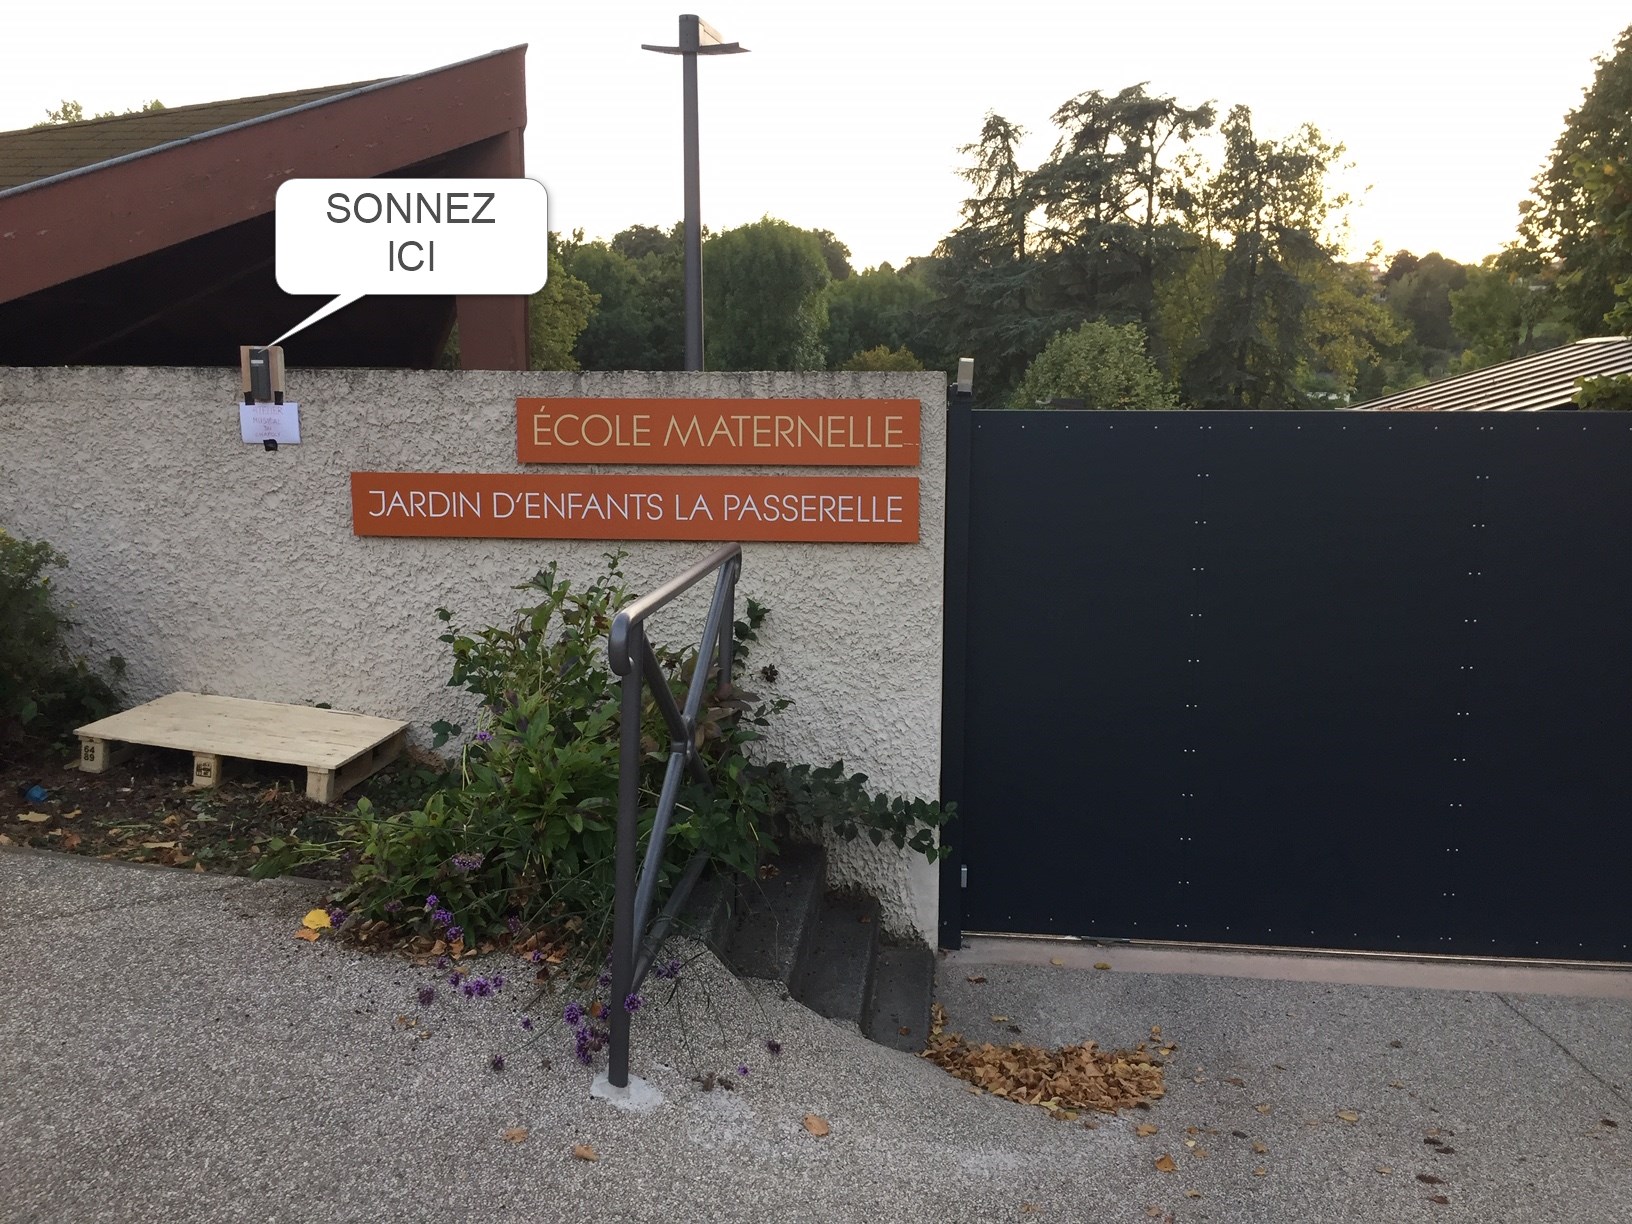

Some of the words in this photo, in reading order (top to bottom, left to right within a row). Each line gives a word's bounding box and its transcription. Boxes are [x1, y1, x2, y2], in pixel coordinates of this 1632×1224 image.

[533, 405, 651, 447] ÉCOLE
[663, 414, 903, 448] MATERNELLE
[368, 490, 482, 518] JARDIN
[675, 494, 714, 521] LA
[724, 494, 903, 523] PASSERELLE
[83, 745, 95, 754] 64
